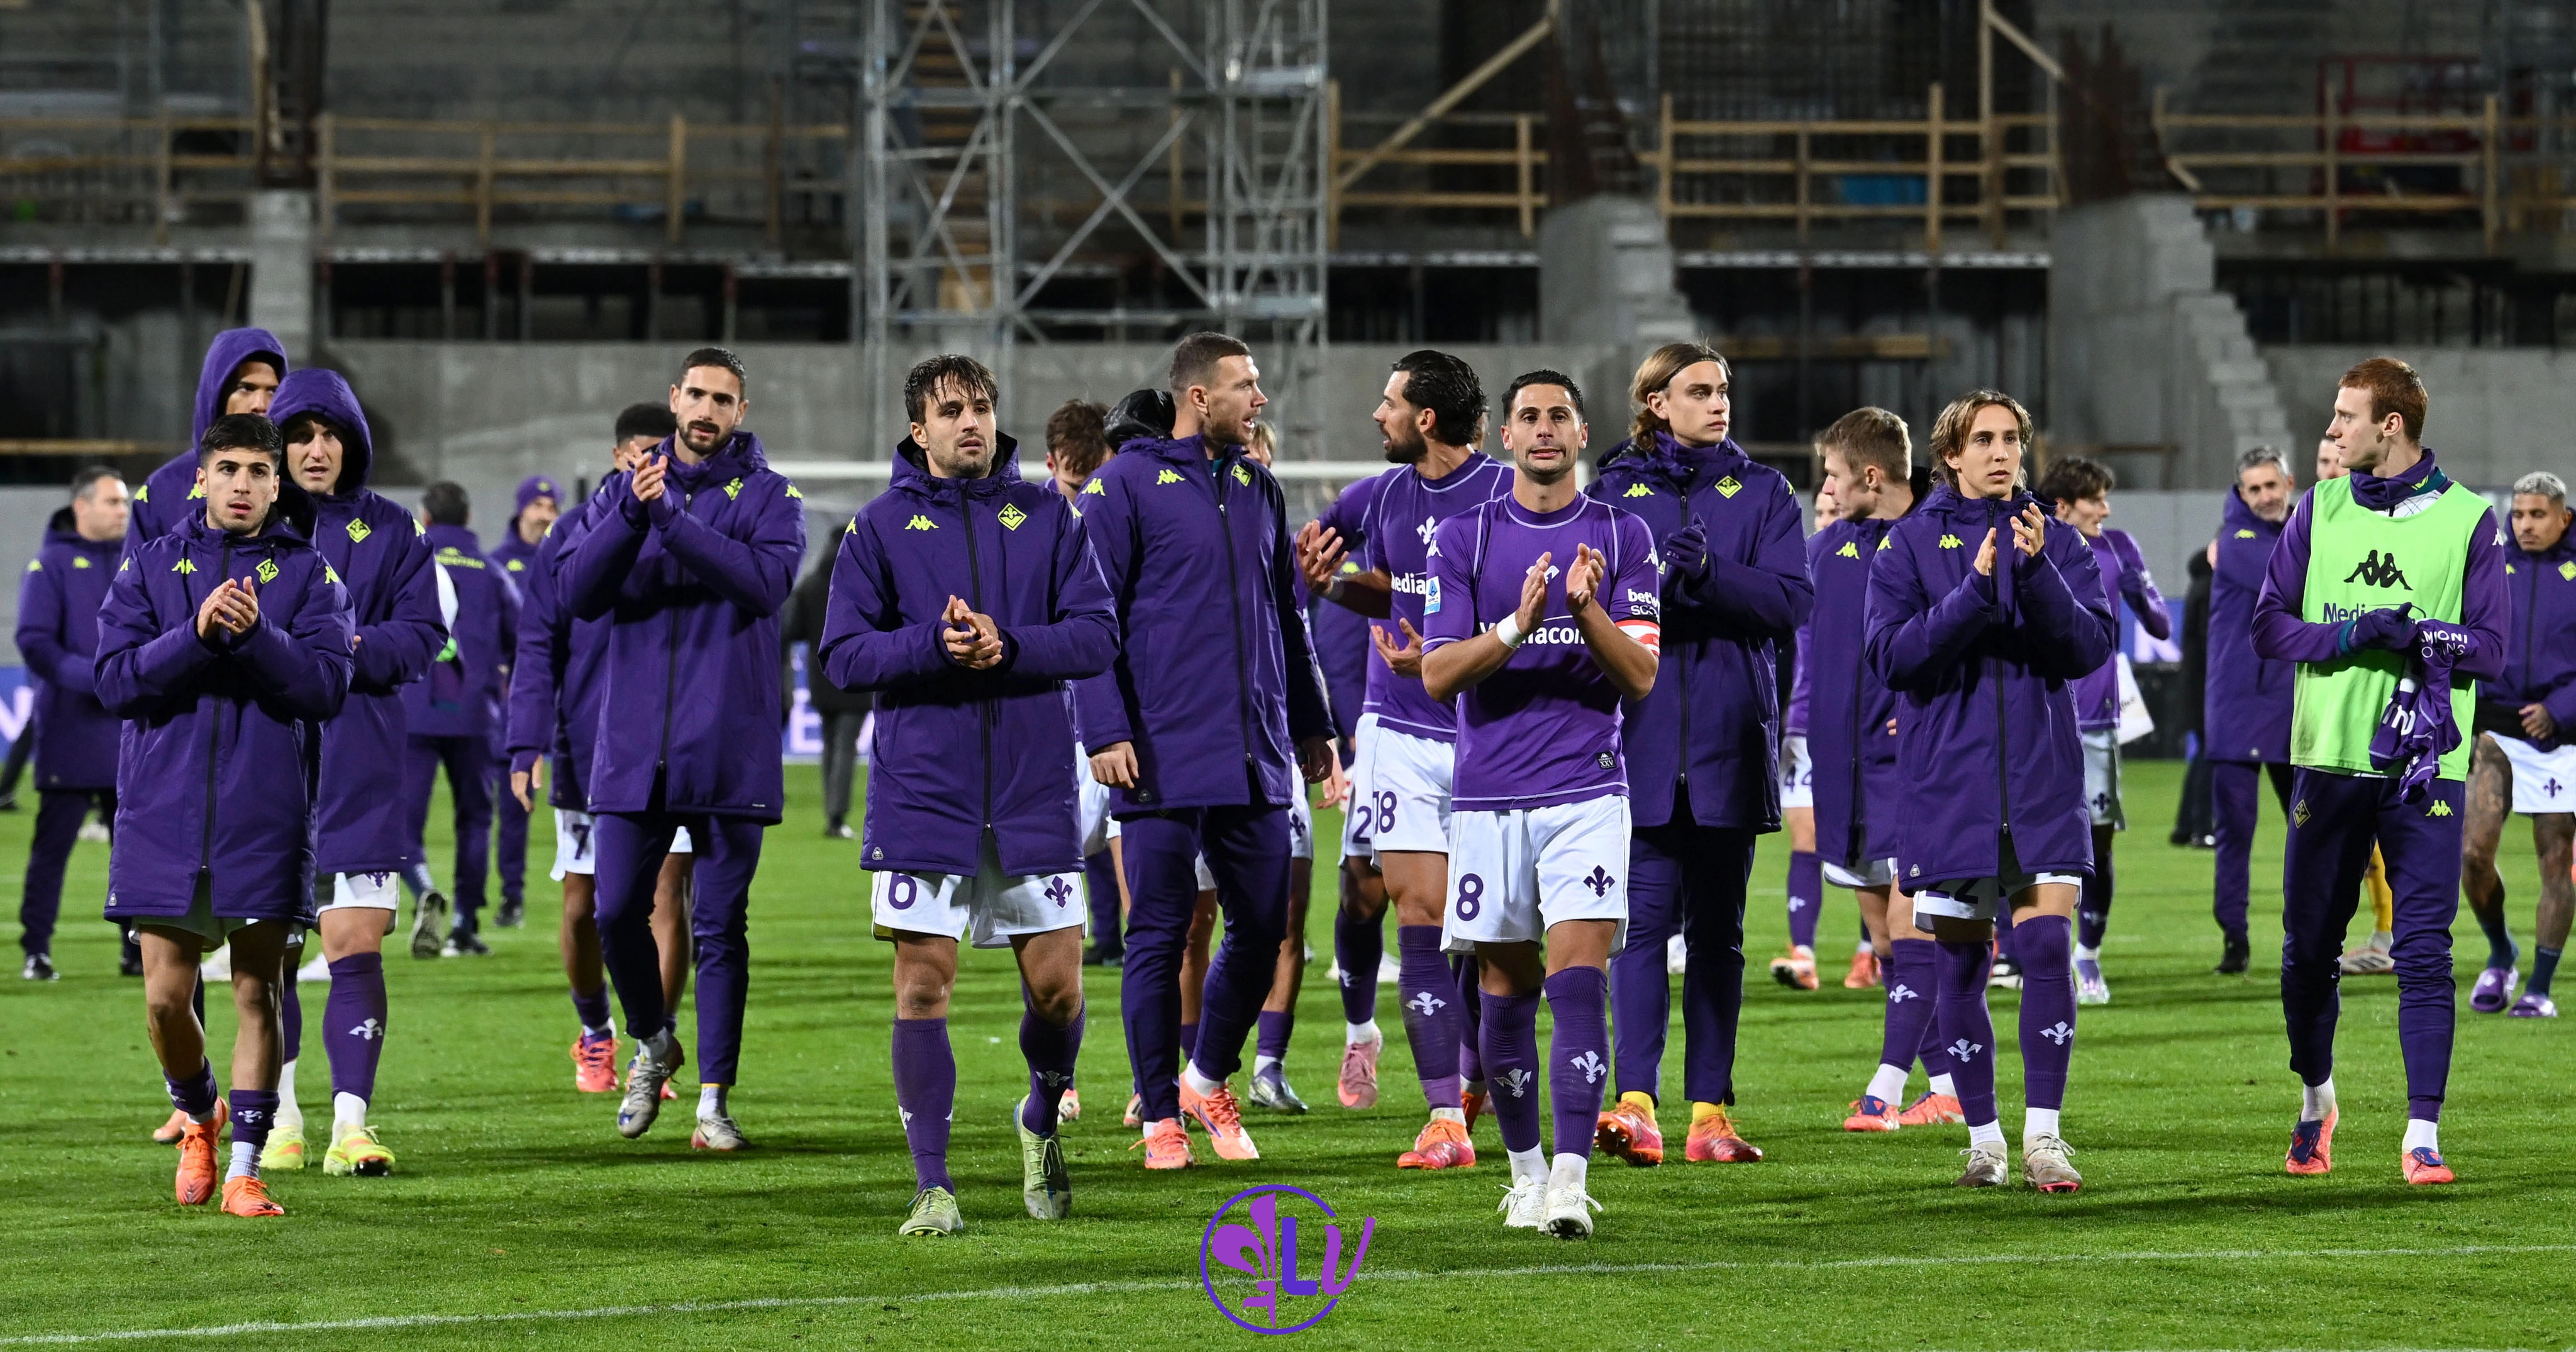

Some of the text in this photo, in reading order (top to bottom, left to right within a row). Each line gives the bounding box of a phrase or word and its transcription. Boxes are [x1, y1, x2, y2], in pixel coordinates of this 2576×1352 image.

[1372, 790, 1397, 834] 18
[572, 824, 591, 860] 7
[888, 872, 918, 910] 6
[1456, 873, 1484, 922] 8
